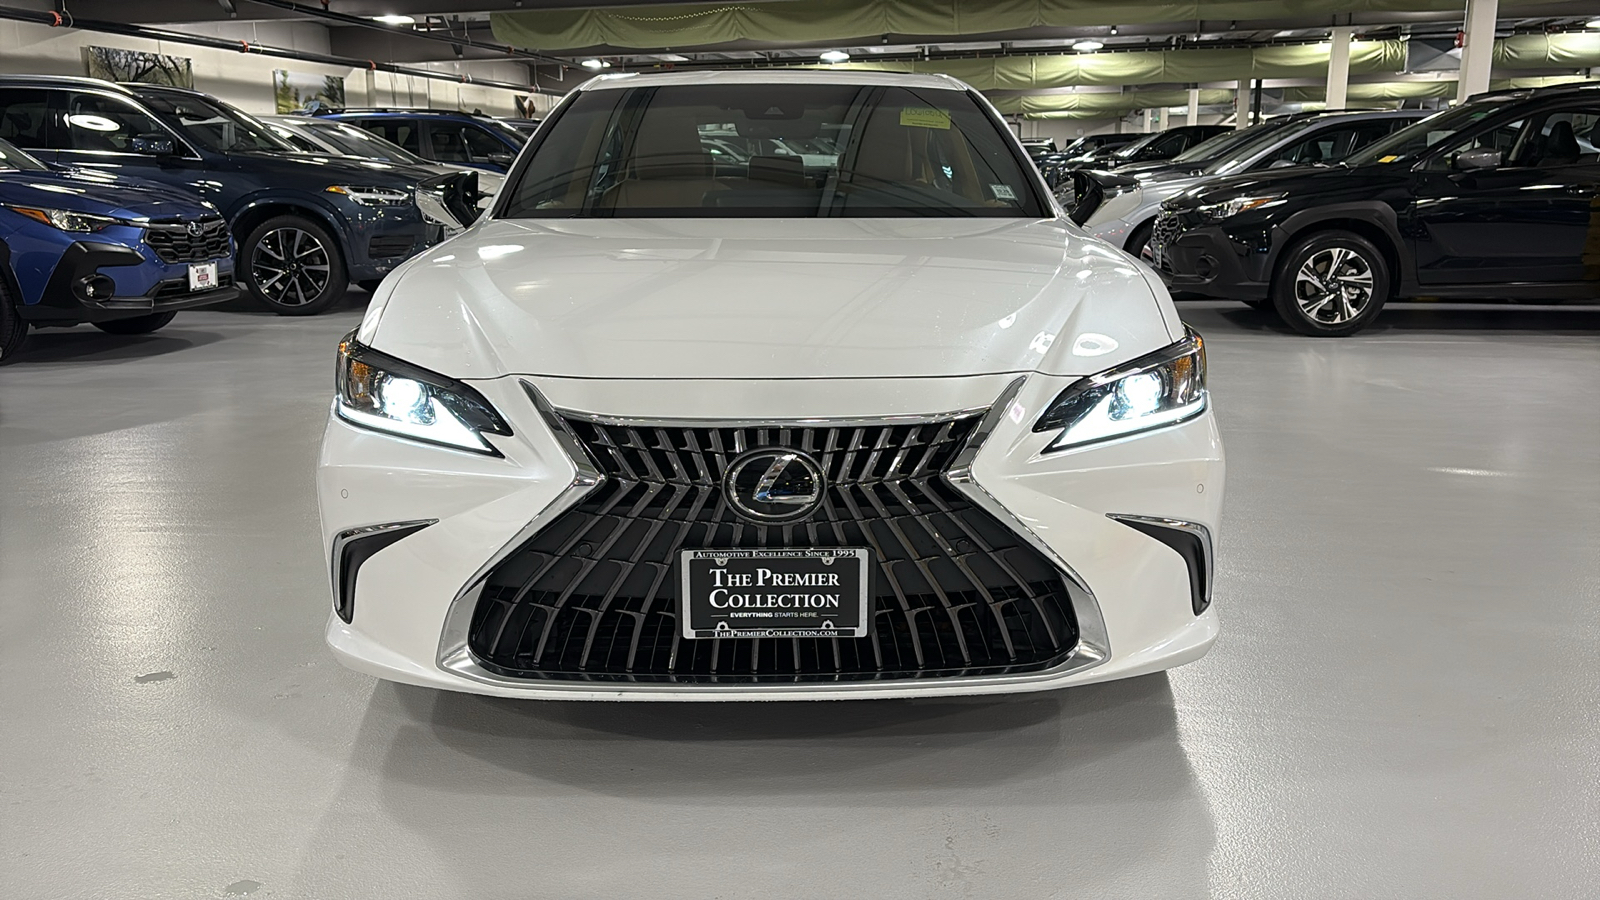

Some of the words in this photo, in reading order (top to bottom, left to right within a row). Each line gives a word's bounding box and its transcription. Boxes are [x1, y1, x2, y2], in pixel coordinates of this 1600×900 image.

[833, 549, 855, 558] 1995
[709, 568, 753, 587] THE
[756, 568, 840, 587] PREMIER
[709, 588, 840, 609] COLLECTION
